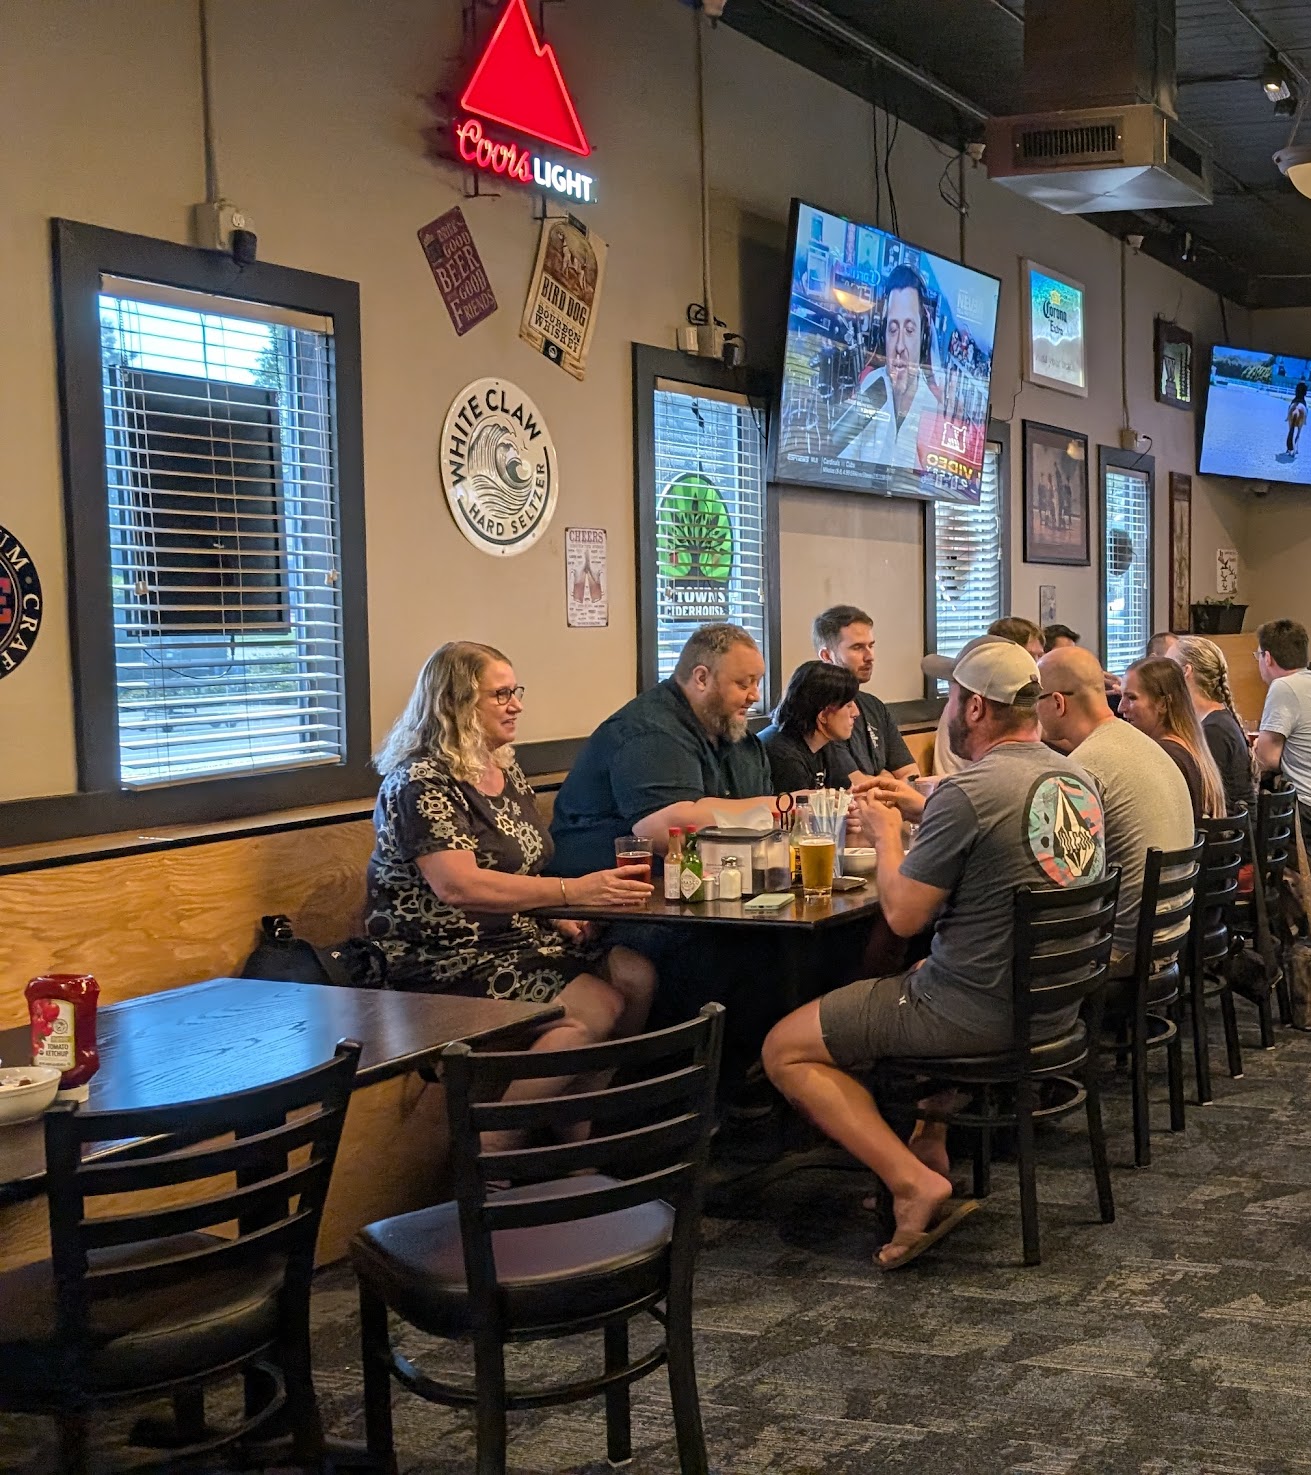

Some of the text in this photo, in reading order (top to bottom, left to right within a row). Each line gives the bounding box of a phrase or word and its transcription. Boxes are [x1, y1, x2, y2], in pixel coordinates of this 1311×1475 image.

[457, 119, 593, 202] Coors LIGHT
[442, 231, 471, 258] GOOD
[435, 245, 480, 294] BEER
[458, 269, 487, 300] GOOD
[450, 288, 496, 329] FRIENDS
[541, 275, 567, 312] BIRD
[566, 295, 588, 328] DOG
[1043, 300, 1067, 323] Corona
[534, 312, 580, 354] WHISKEY
[536, 303, 582, 344] BOURBON
[1049, 320, 1064, 336] Extra
[449, 388, 542, 486] WHITE CLAW
[469, 462, 545, 536] HARD SELTZER
[569, 529, 604, 544] CHEERS
[665, 604, 726, 617] CIDERHOUSE
[674, 586, 726, 603] TOWNS
[0, 593, 40, 674] CRAF
